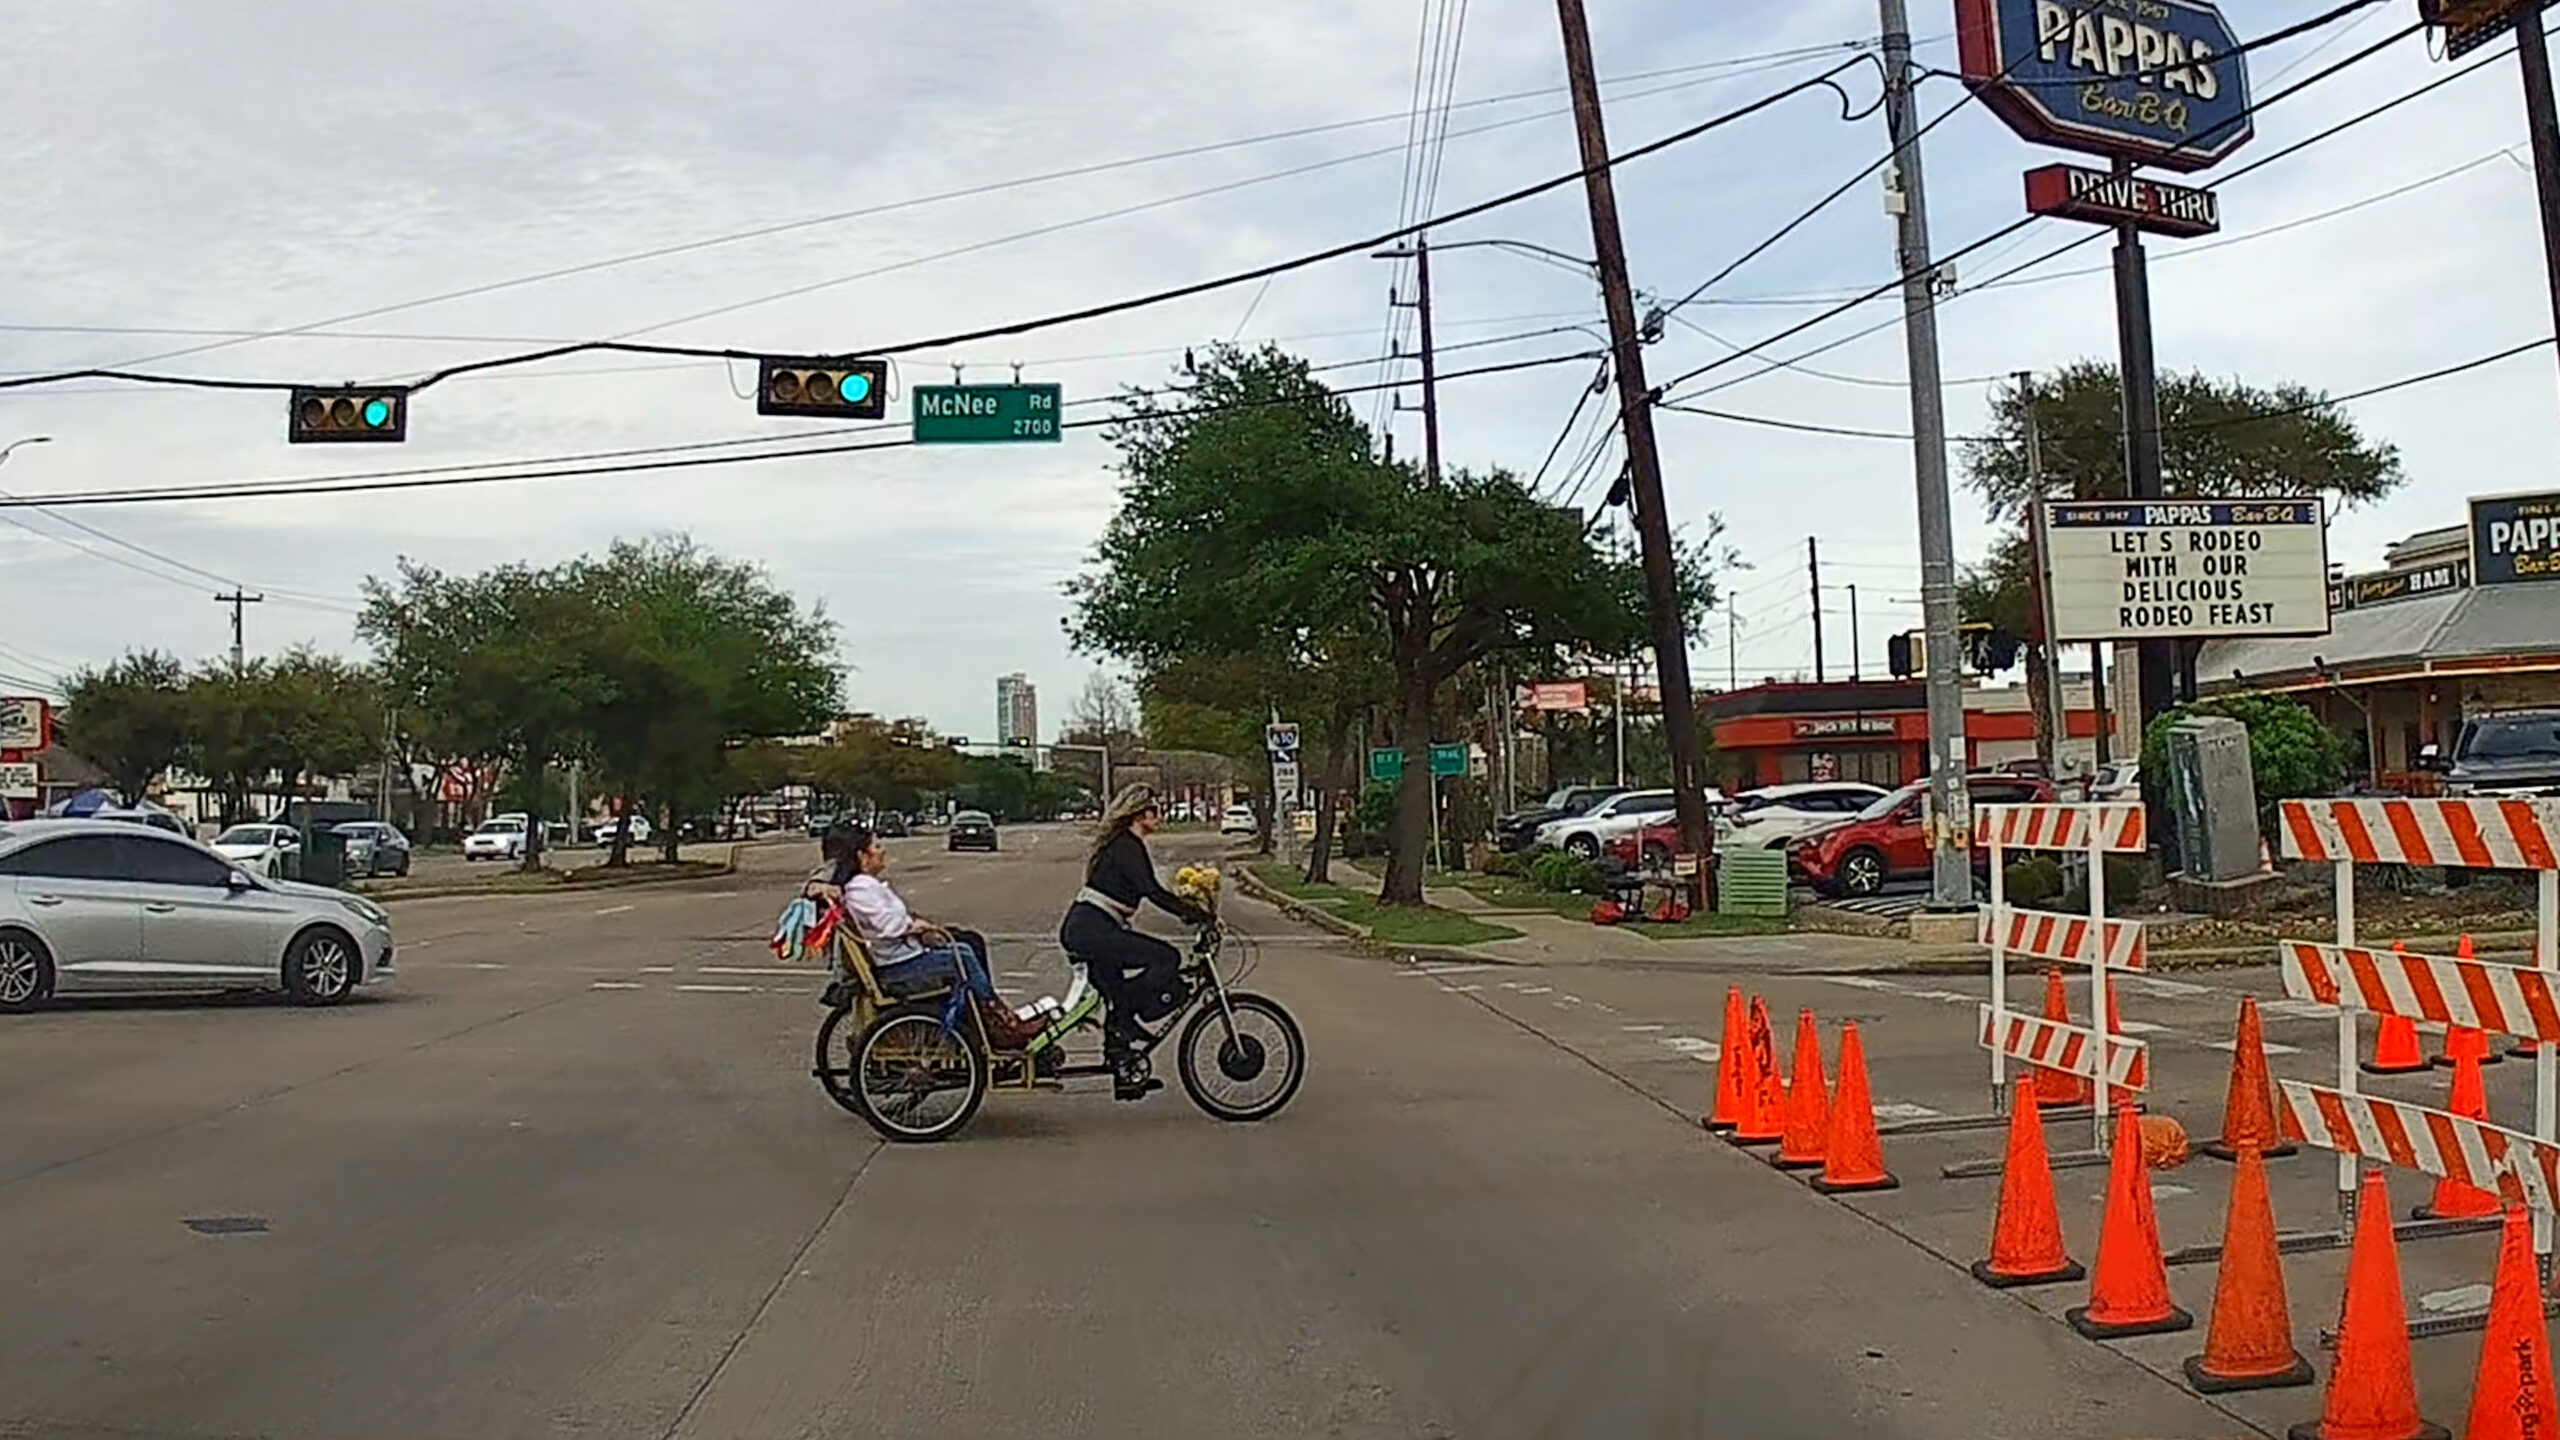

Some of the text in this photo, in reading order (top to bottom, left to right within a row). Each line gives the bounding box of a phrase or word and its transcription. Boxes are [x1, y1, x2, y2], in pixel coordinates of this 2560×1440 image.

[2036, 0, 2218, 99] PAPPAS
[2069, 170, 2219, 225] DRIVE THRU
[921, 393, 1052, 417] McNee Rd
[1013, 419, 1052, 435] 2700
[2144, 505, 2211, 524] PAPPAS
[2111, 531, 2148, 553] LET
[2189, 530, 2262, 552] RODEO
[2126, 554, 2248, 578] WITH OUR
[2123, 579, 2243, 603] DELICIOUS
[2410, 567, 2450, 591] HAM
[2120, 603, 2275, 628] RODEO FEAST
[2512, 1337, 2539, 1386] park
